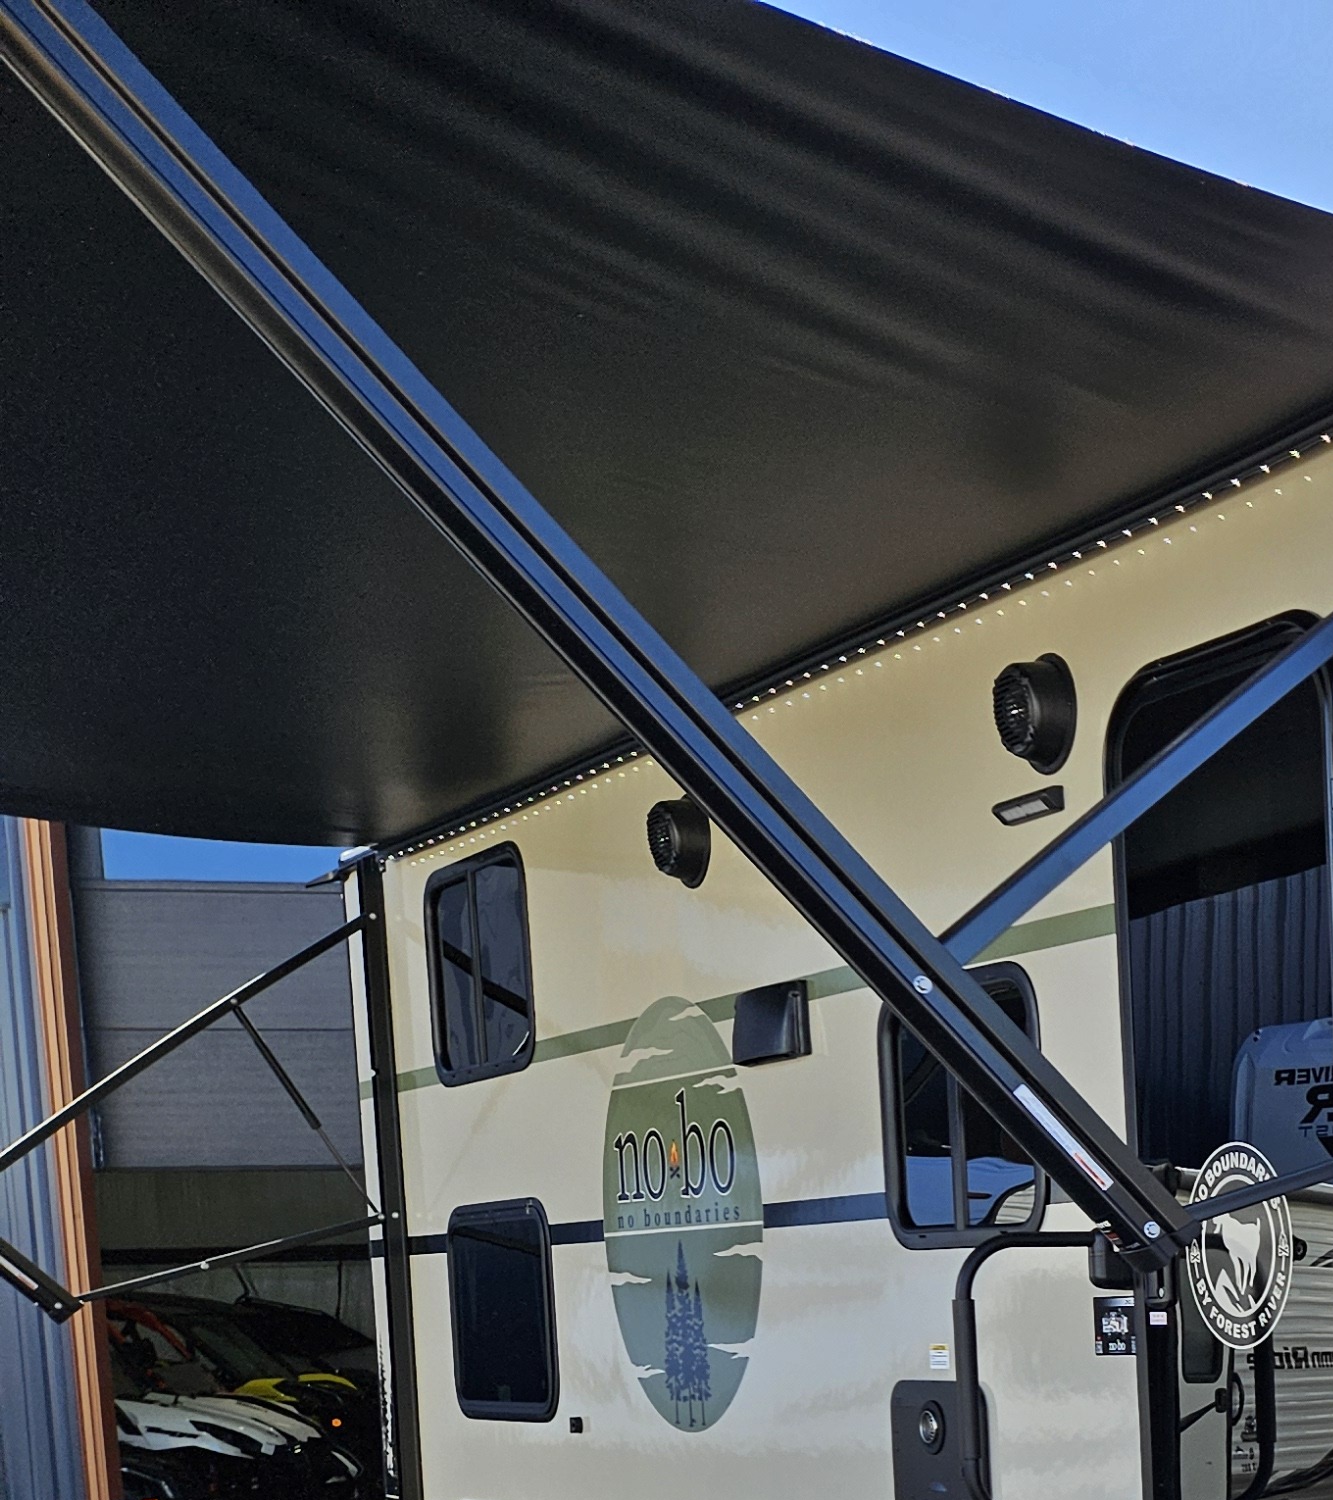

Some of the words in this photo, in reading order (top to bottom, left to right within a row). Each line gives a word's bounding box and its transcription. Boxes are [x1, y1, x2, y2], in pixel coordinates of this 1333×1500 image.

[617, 1213, 635, 1229] no
[643, 1201, 741, 1227] boundaries
[1196, 1277, 1213, 1307] BY
[1208, 1306, 1258, 1340] FOREST
[1258, 1272, 1287, 1328] RIVER
